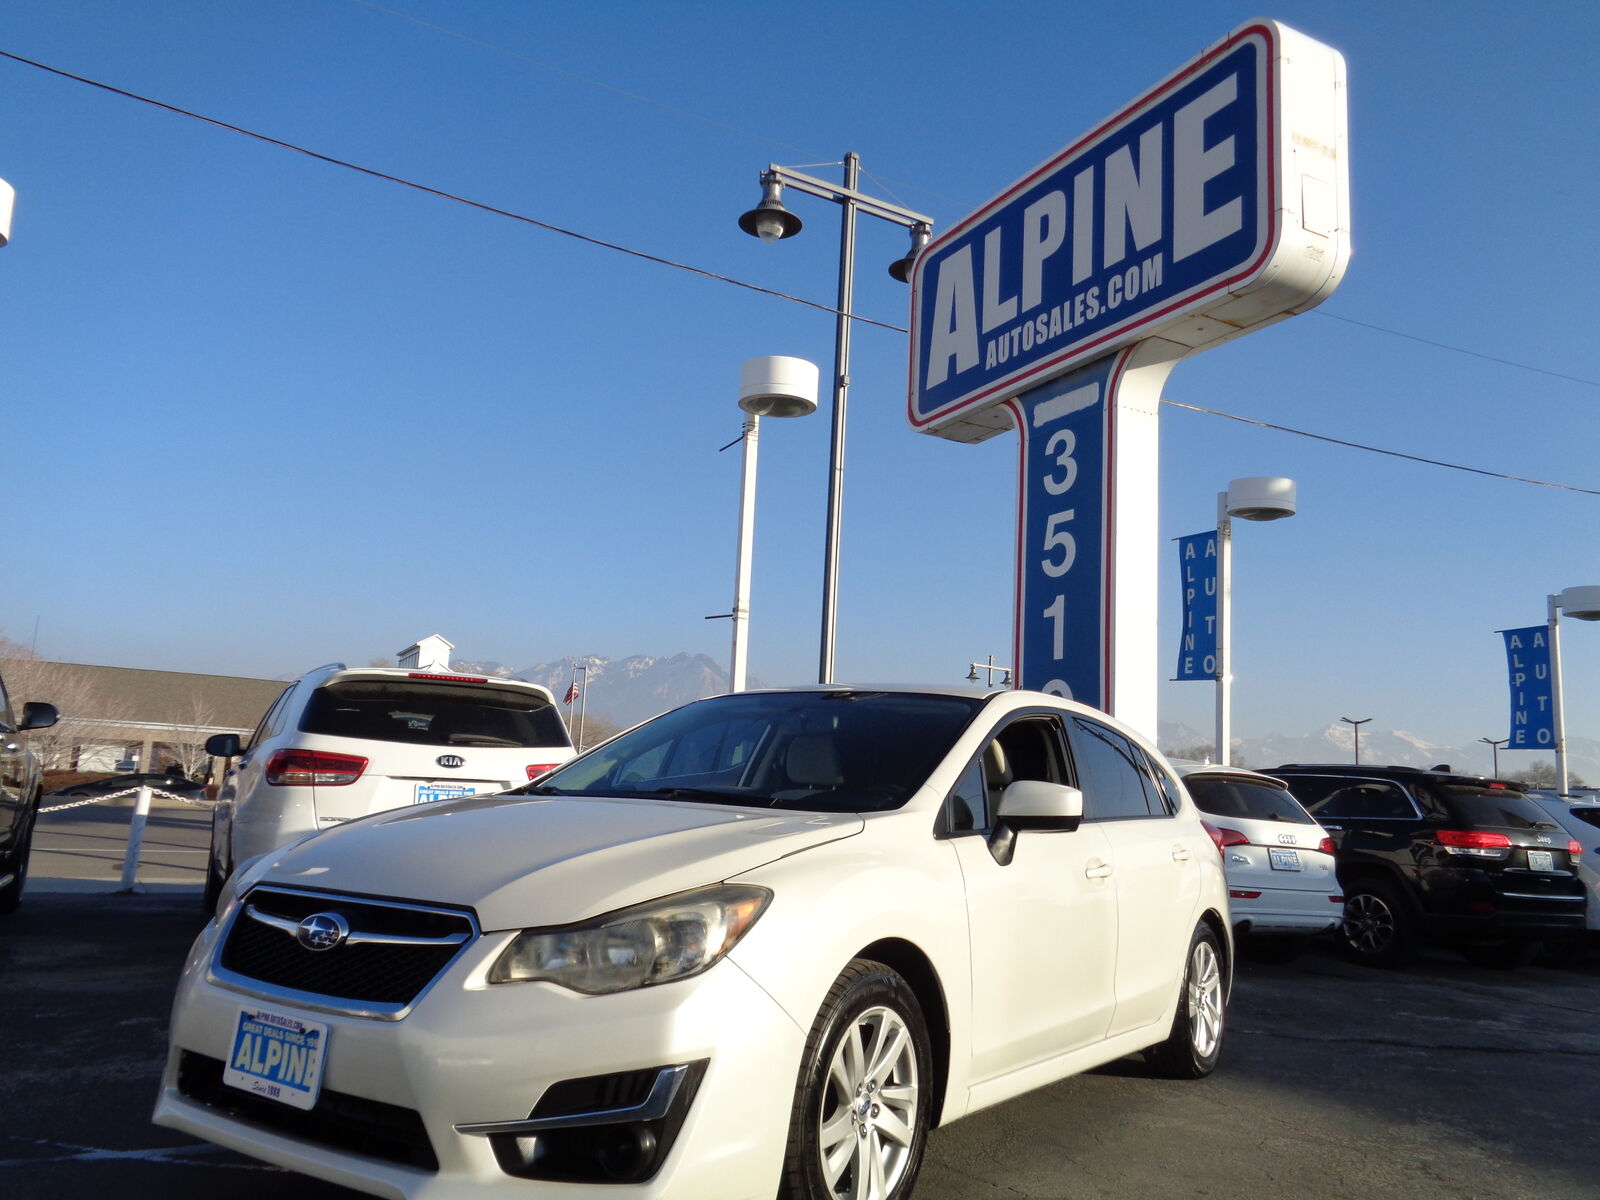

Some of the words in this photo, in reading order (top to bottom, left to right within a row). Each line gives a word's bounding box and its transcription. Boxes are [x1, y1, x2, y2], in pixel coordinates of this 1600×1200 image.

[926, 72, 1243, 390] ALPINE
[985, 252, 1163, 370] AUTOSALES.COM
[1041, 428, 1078, 702] 351
[1184, 543, 1195, 674] ALPINE
[1203, 538, 1217, 674] AUTO
[1510, 634, 1528, 744] ALPINE
[1533, 632, 1551, 745] AUTO
[440, 756, 461, 766] KIA
[1536, 835, 1551, 844] Jeep
[243, 1022, 262, 1034] GREAT
[264, 1026, 283, 1039] DEALS
[285, 1031, 305, 1045] SINCE
